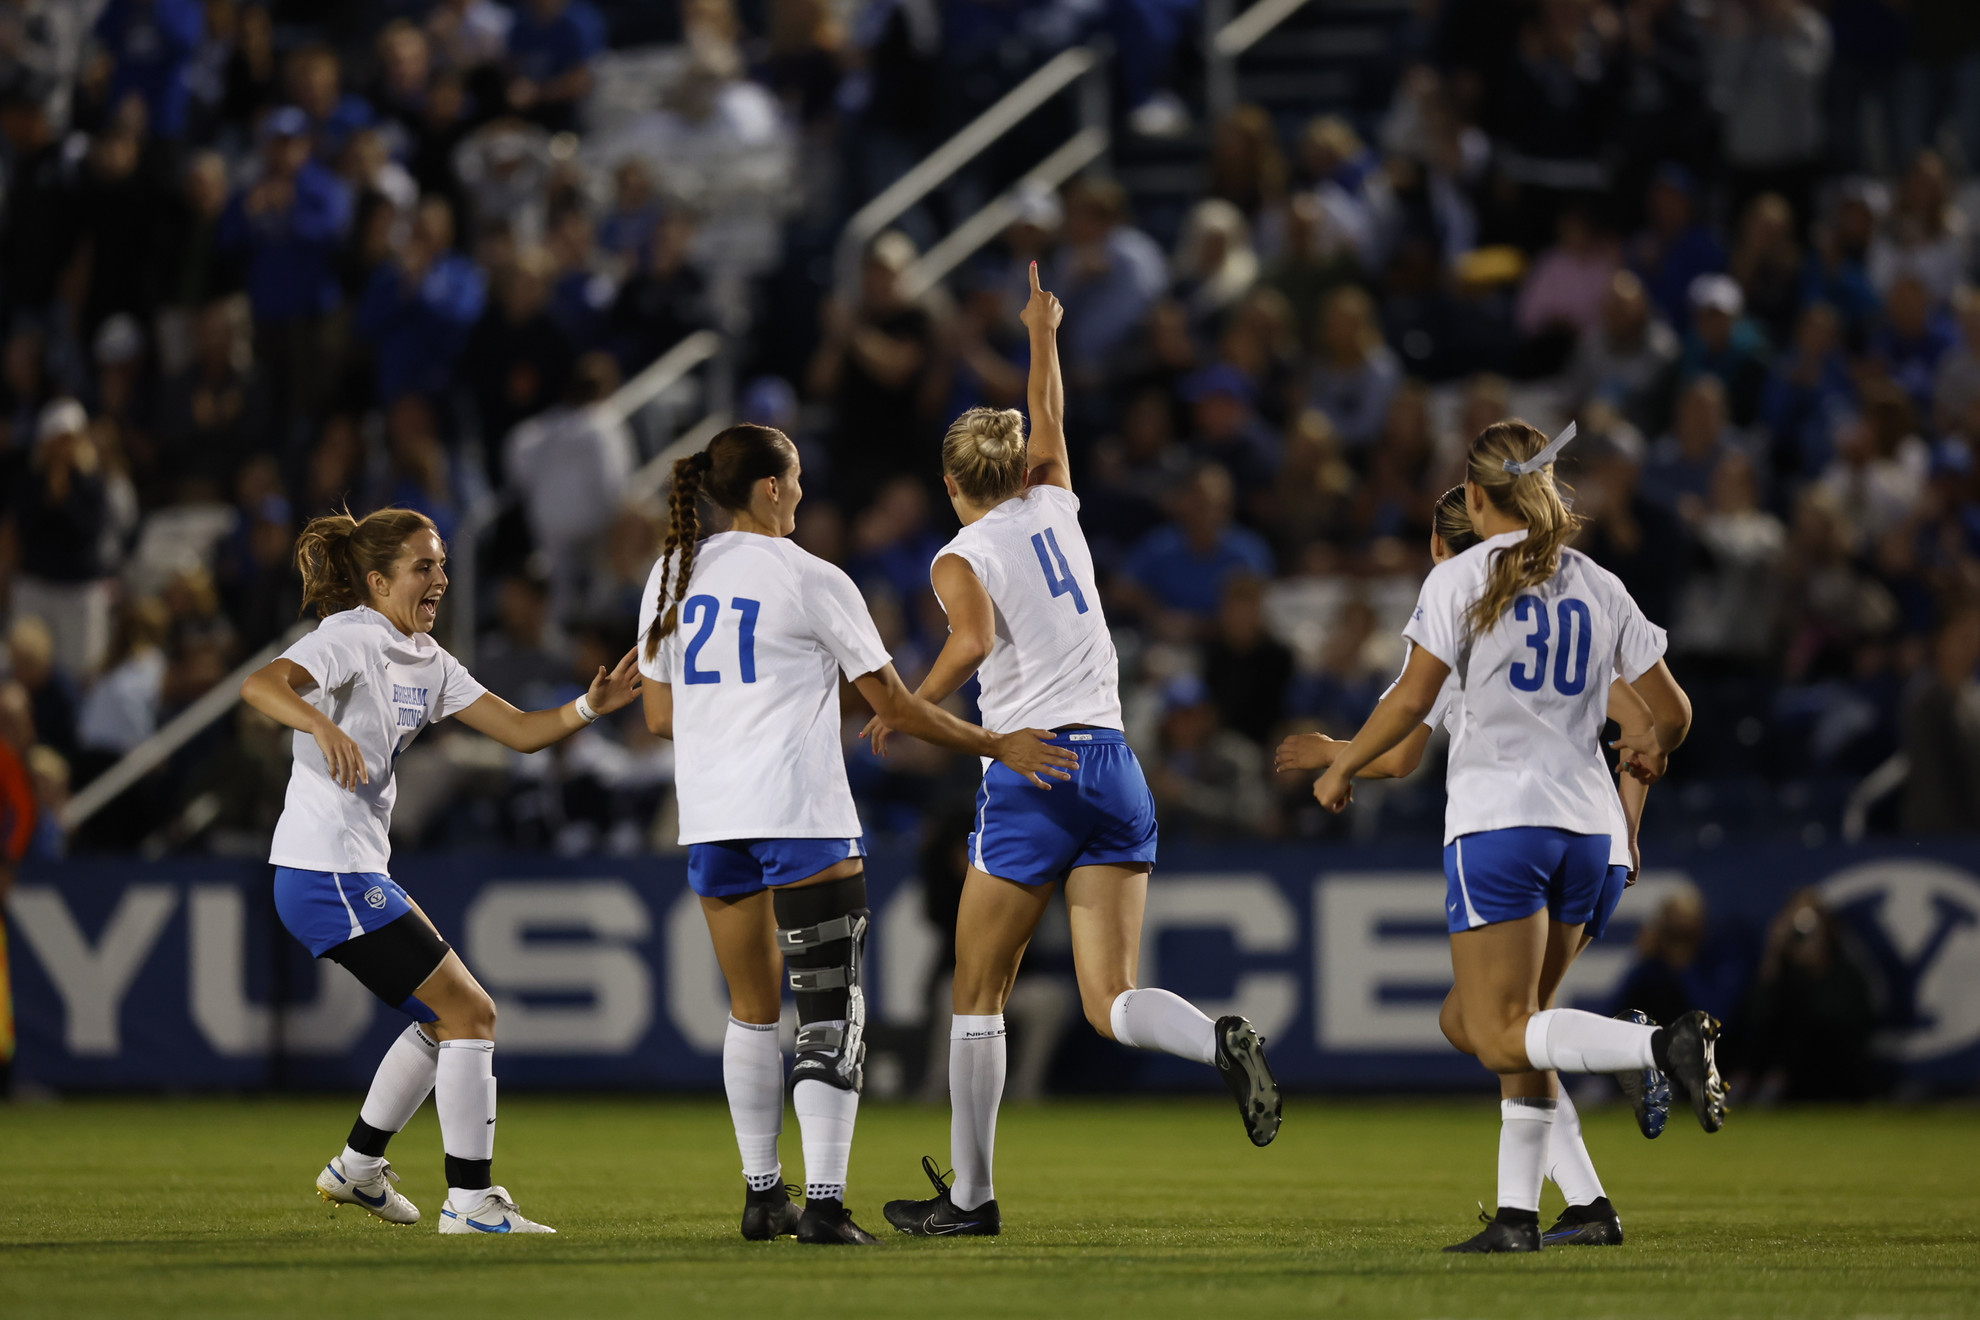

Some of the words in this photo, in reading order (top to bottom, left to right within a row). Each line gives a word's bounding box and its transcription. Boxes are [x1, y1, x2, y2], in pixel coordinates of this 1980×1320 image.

[1031, 527, 1089, 615] 4
[682, 594, 761, 686] 21
[1509, 594, 1592, 697] 30
[396, 707, 422, 729] YOUNG
